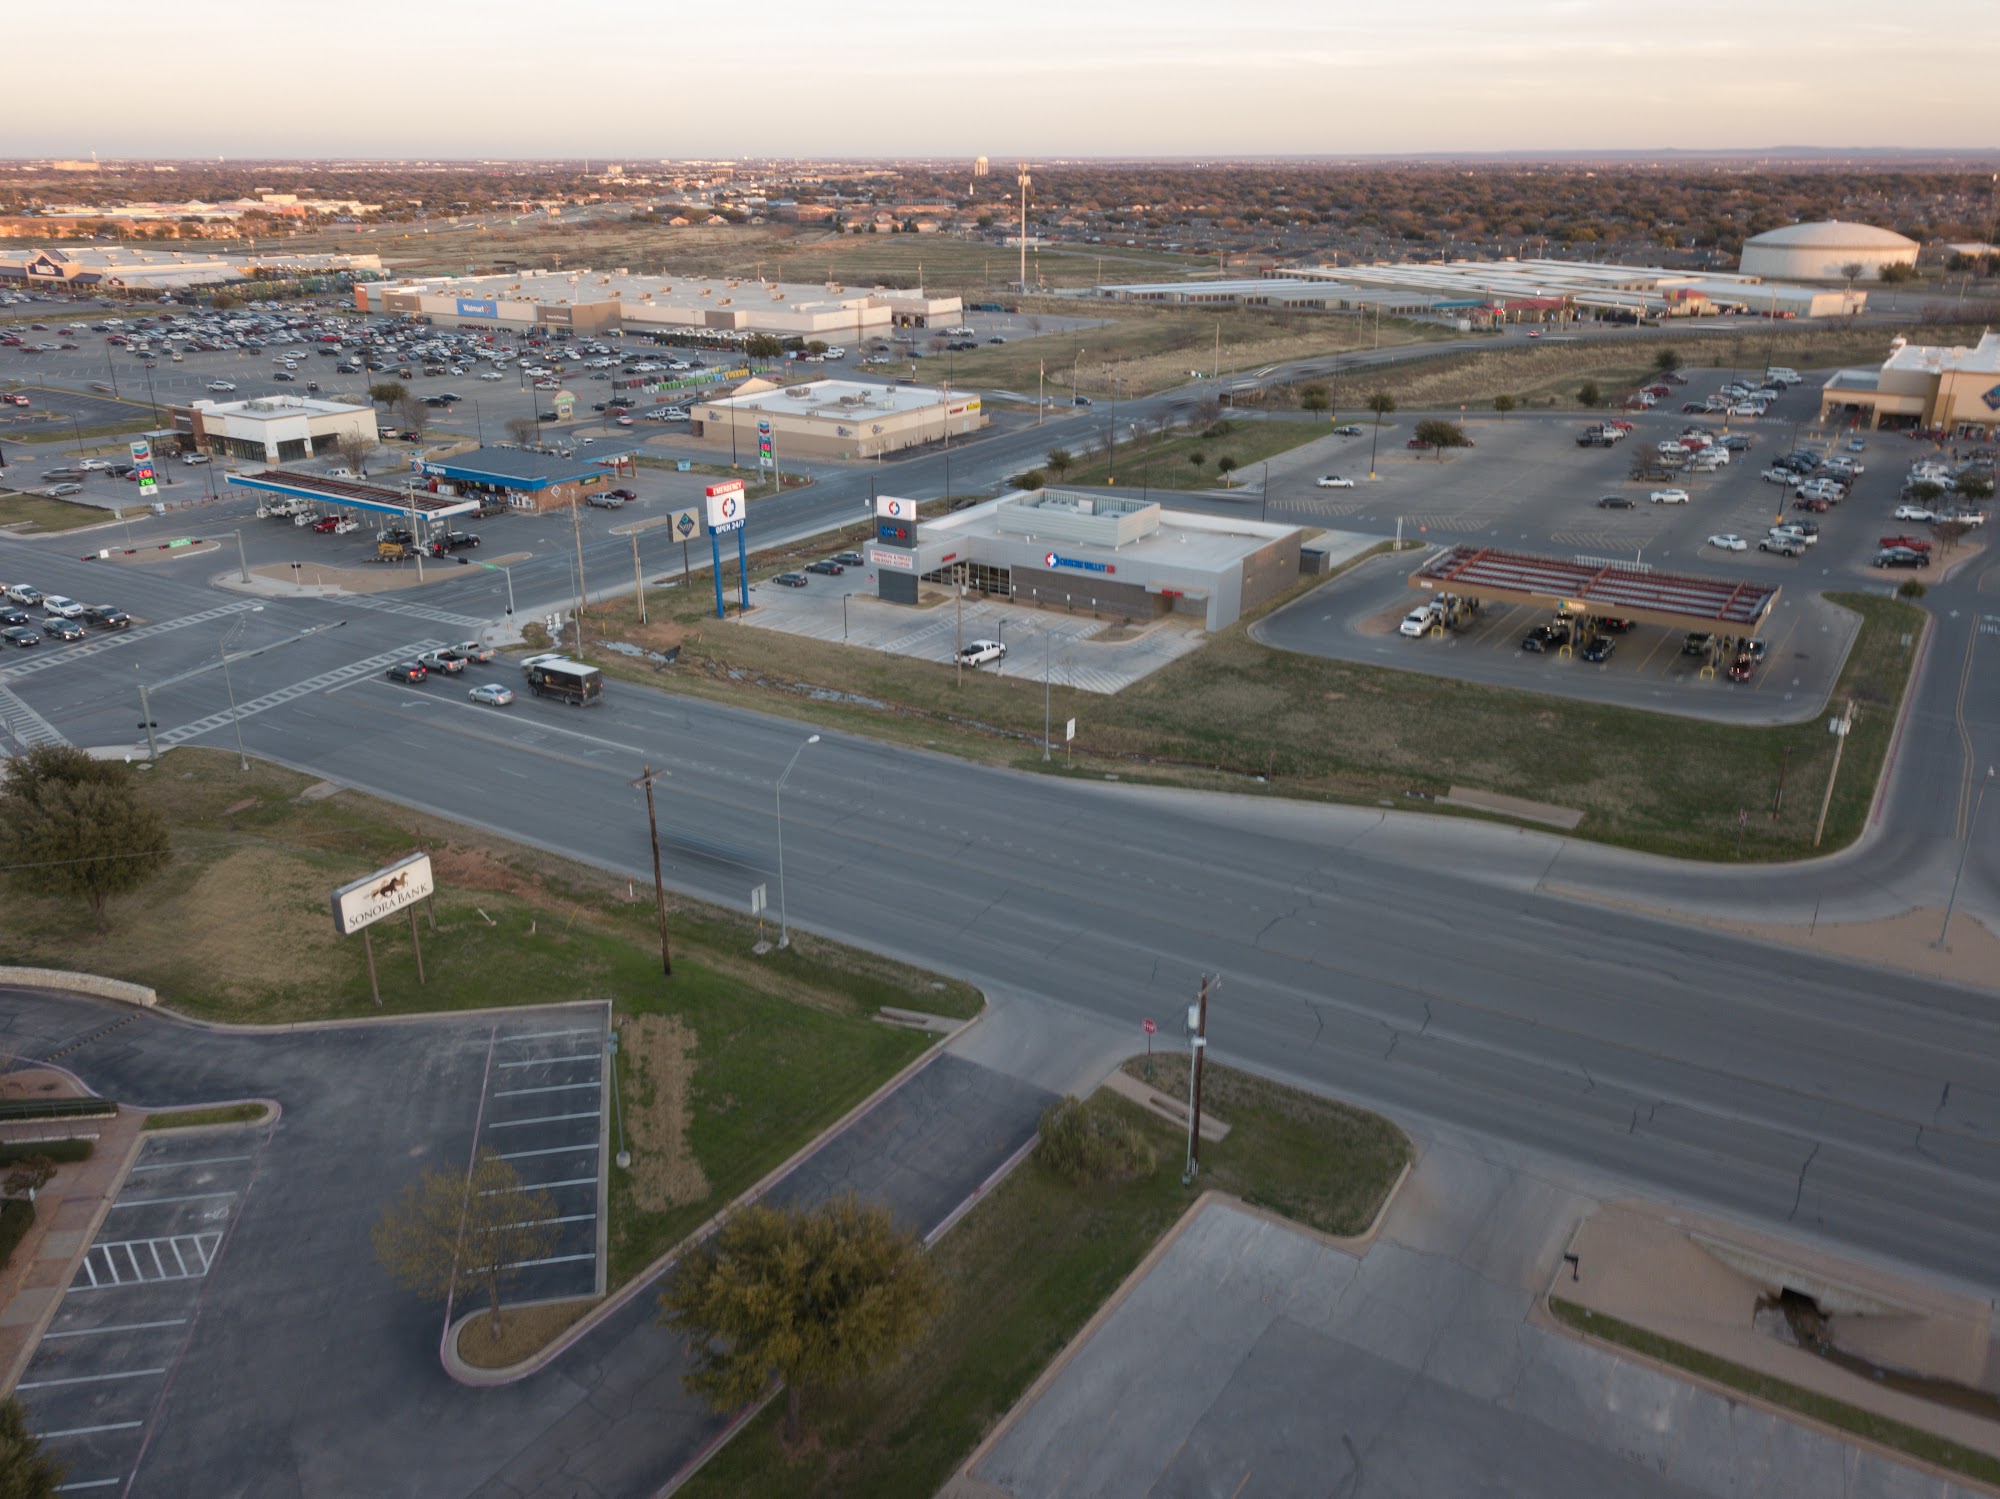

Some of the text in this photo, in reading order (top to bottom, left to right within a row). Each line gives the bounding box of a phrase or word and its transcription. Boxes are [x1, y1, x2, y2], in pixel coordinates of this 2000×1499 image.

[463, 303, 485, 314] Walmart
[426, 465, 446, 475] stripes
[713, 481, 742, 496] EMERGENCY
[715, 520, 745, 535] OPEN 24/7
[349, 882, 428, 928] SONORA BANK
